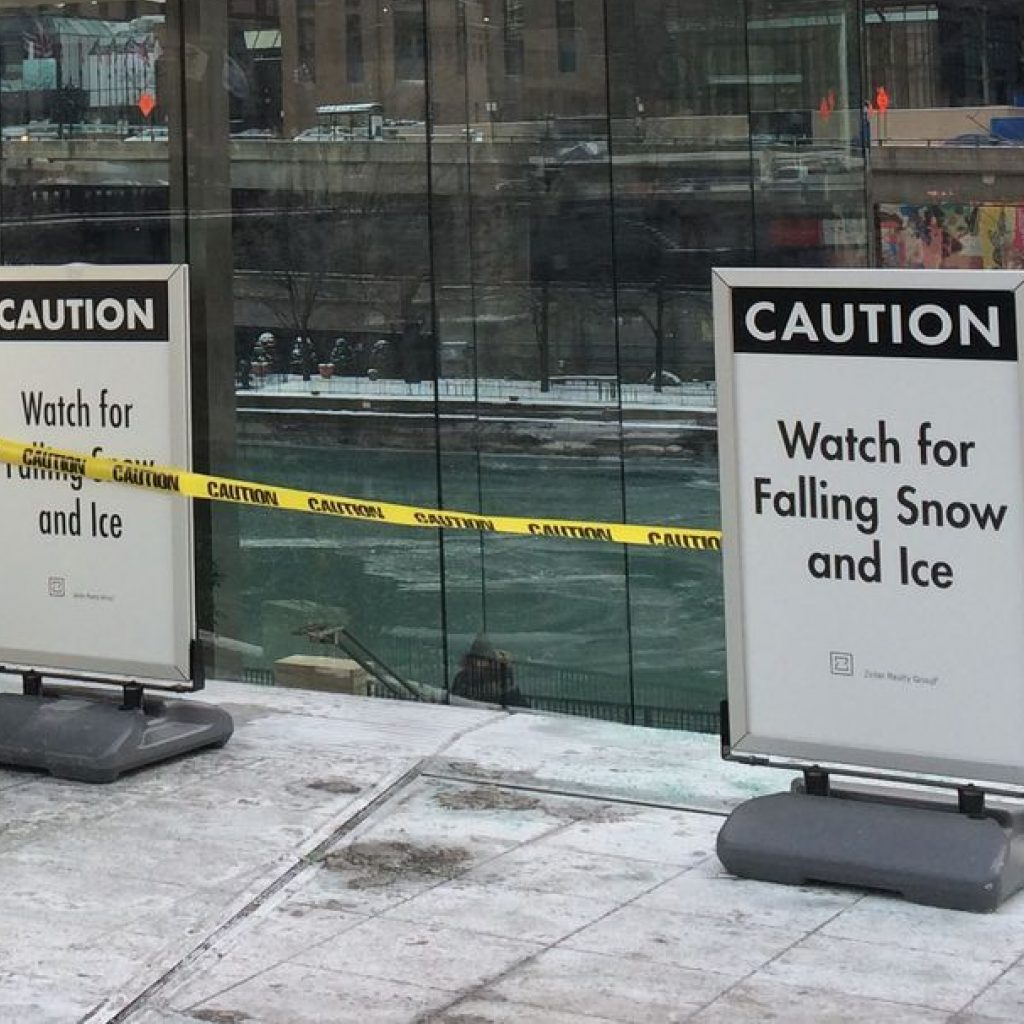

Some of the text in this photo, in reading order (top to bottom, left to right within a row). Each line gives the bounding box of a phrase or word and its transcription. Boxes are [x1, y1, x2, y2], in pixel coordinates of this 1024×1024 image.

[744, 300, 1001, 348] CAUTION
[20, 388, 134, 429] Watch for
[776, 420, 976, 468] Watch for
[22, 446, 87, 476] CAUTION
[112, 463, 181, 492] CAUTION
[207, 481, 279, 506] CAUTION
[307, 498, 385, 520] CAUTION
[528, 523, 613, 542] CAUTION
[648, 531, 721, 551] CAUTIO
[39, 497, 124, 539] and Ice
[754, 474, 1009, 536] Falling Snow
[807, 539, 955, 589] and Ice
